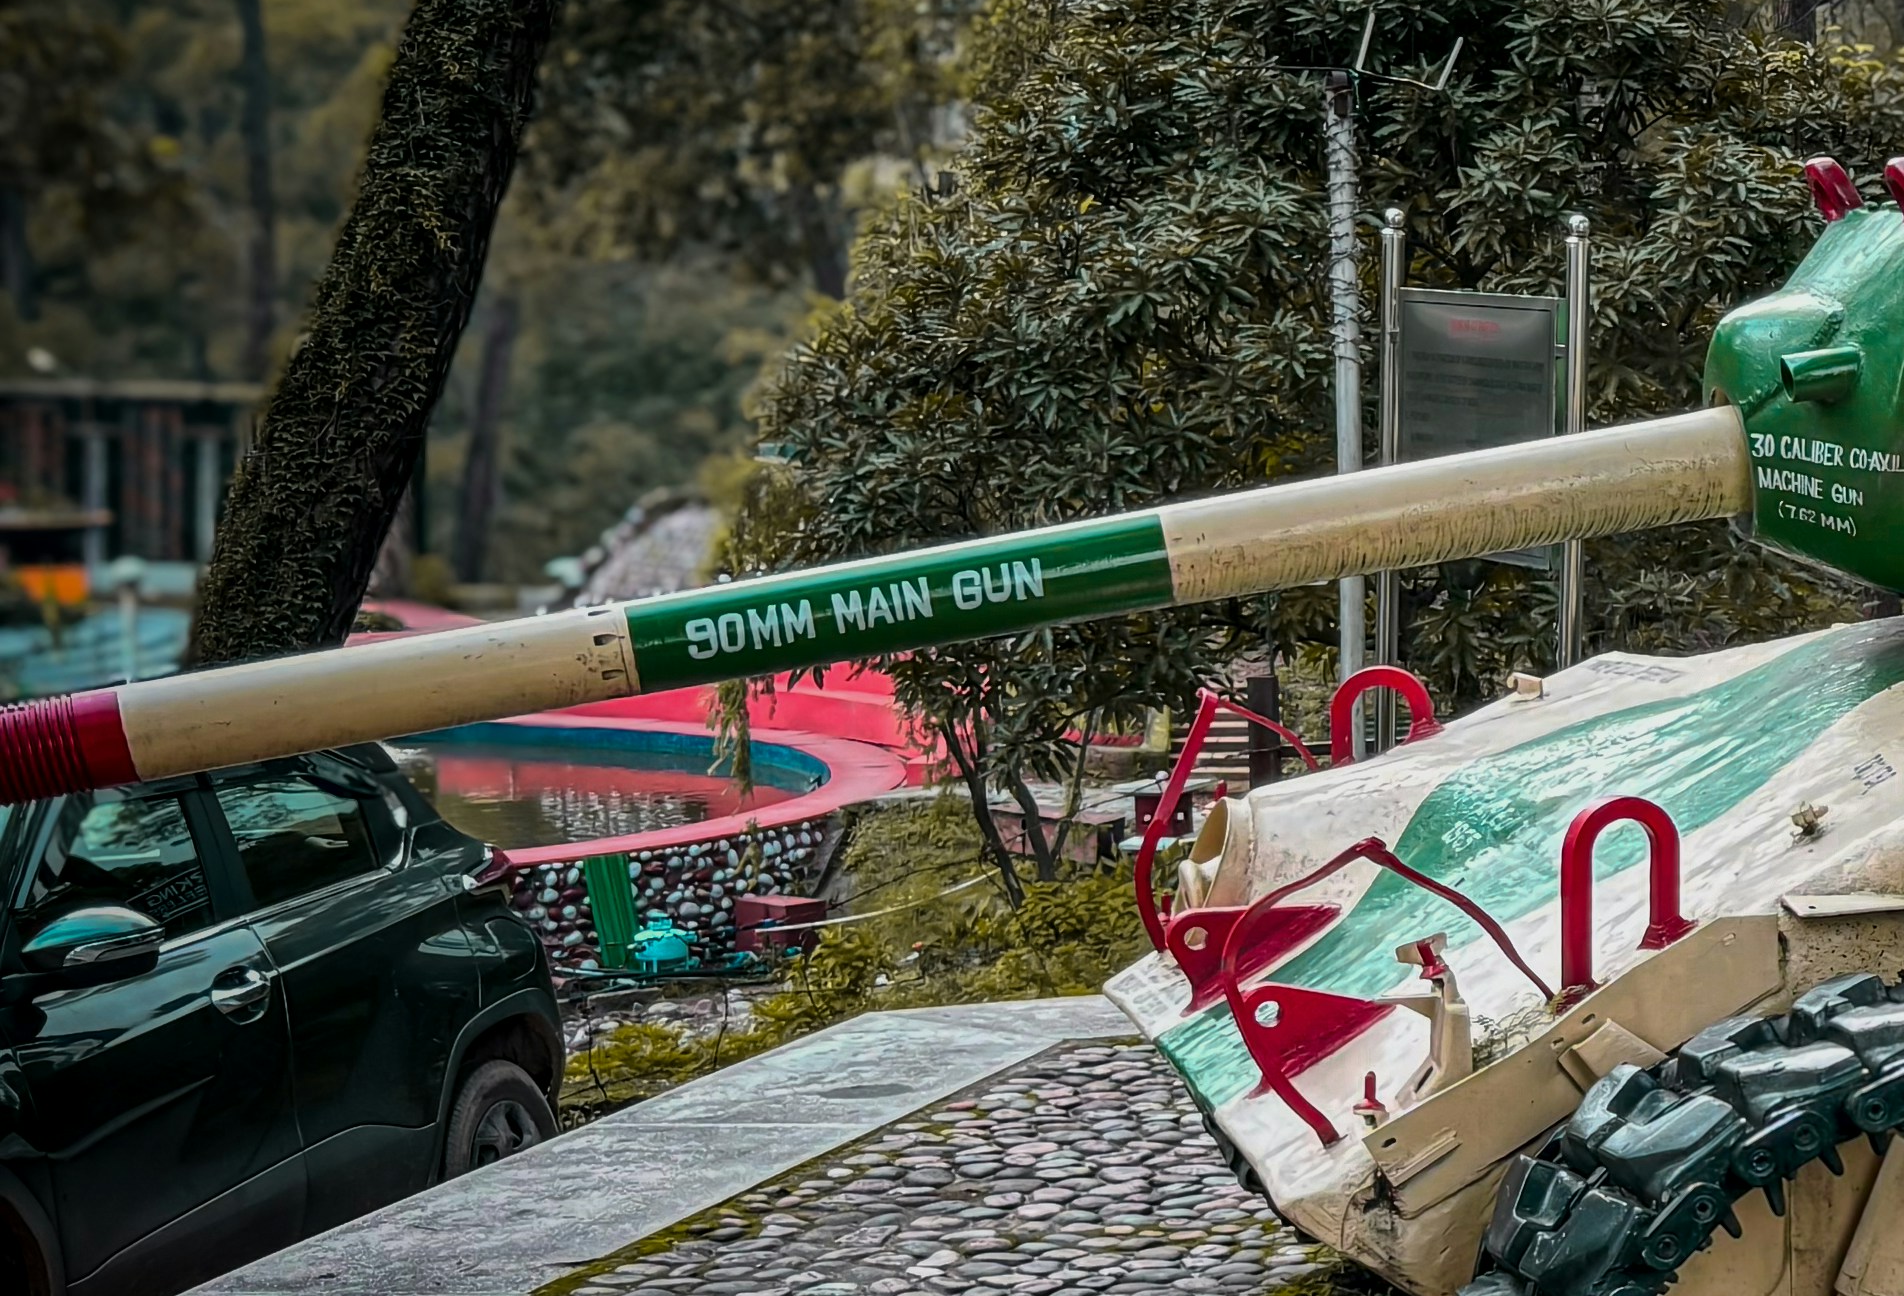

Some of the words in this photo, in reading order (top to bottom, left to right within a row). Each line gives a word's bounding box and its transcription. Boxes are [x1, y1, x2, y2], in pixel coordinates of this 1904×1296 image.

[1750, 432, 1776, 458] 30
[1780, 435, 1844, 467] CALIBER
[1757, 465, 1824, 500] MACHINE
[1831, 482, 1864, 506] GUN
[1820, 512, 1857, 537] MM)
[685, 599, 816, 660] 90MM
[831, 576, 934, 635] MAIN
[952, 557, 1045, 611] GUN
